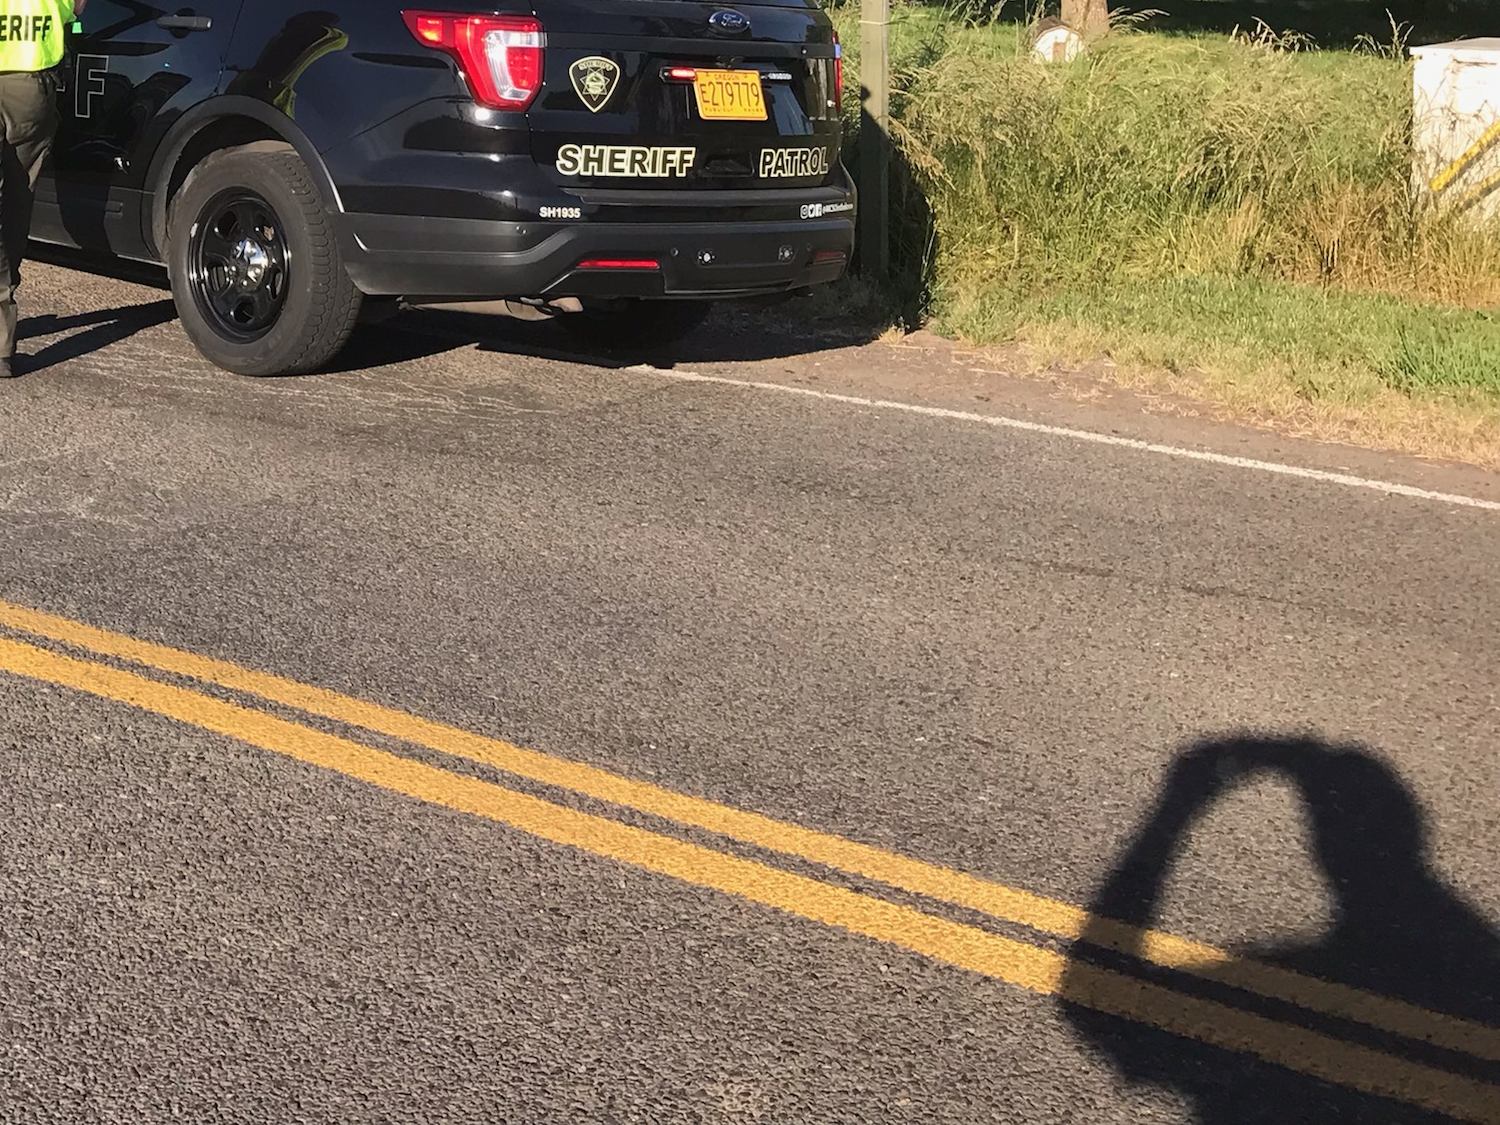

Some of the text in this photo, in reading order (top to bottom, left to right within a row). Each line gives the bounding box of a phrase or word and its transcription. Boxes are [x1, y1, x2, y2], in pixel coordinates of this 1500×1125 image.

[720, 13, 743, 27] Ford
[699, 80, 761, 107] E279779
[556, 144, 829, 178] SHERIFF PATROL
[539, 206, 581, 219] SH1935
